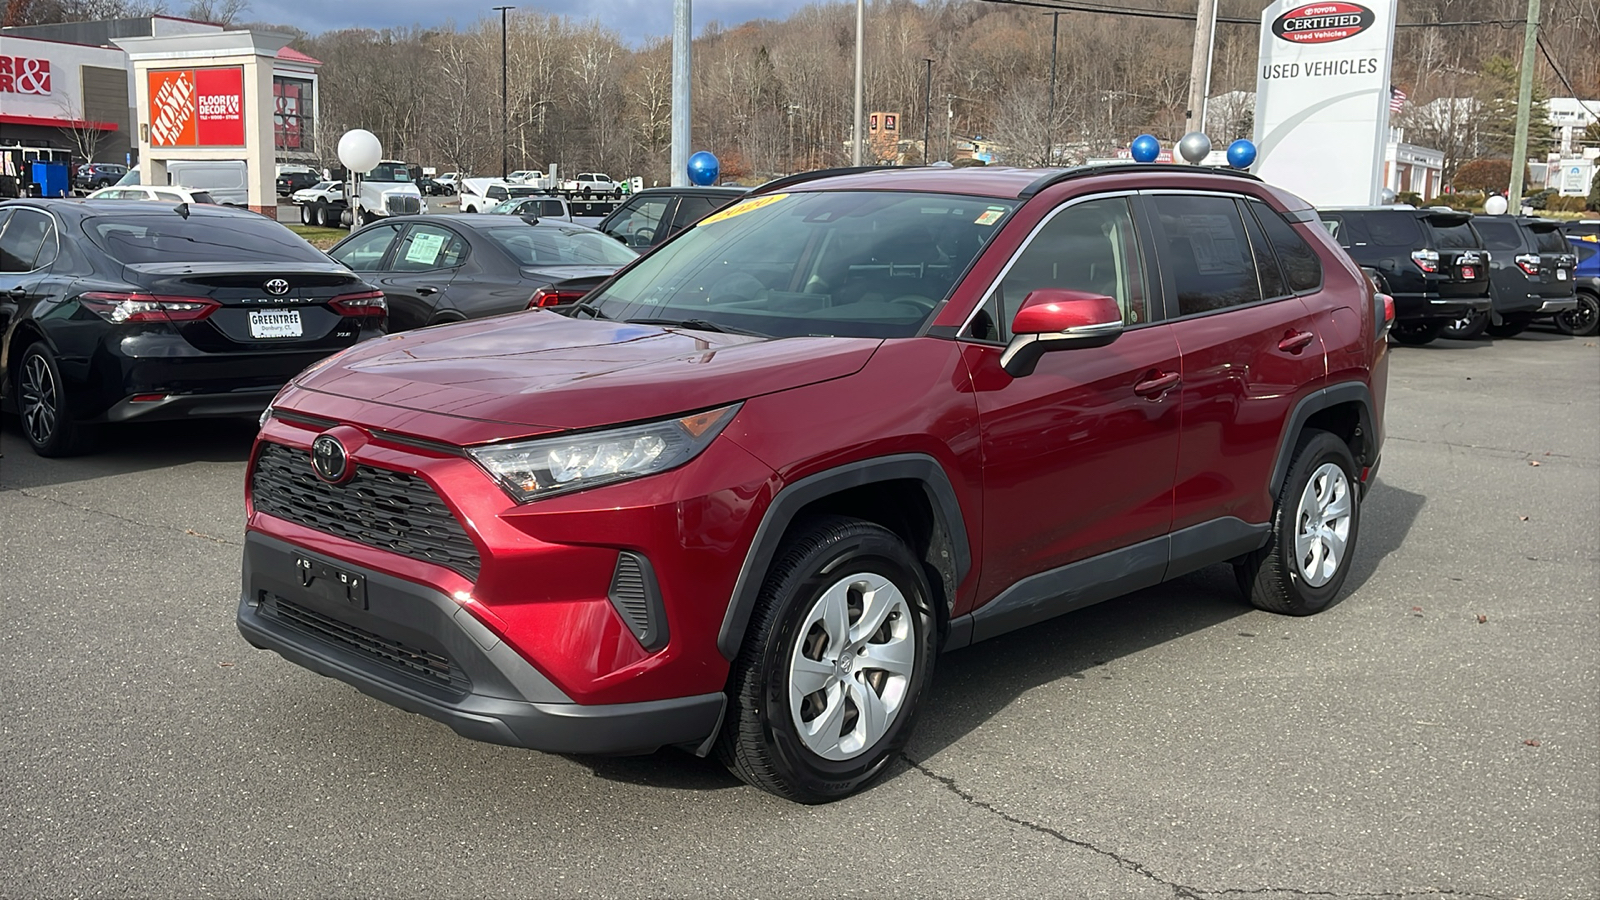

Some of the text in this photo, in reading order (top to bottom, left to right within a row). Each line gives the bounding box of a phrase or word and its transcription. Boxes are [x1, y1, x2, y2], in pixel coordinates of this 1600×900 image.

[1312, 6, 1337, 14] TOYOTA
[1283, 15, 1361, 31] CERTIFIED
[1294, 30, 1347, 41] Used Vehicles
[1263, 58, 1378, 80] USED VEHICLES
[154, 77, 174, 109] THE
[199, 95, 226, 105] FLOOR
[151, 72, 193, 146] HOME
[199, 105, 226, 115] DECOR
[167, 97, 195, 146] DEPOT
[251, 314, 299, 325] GREENTREE
